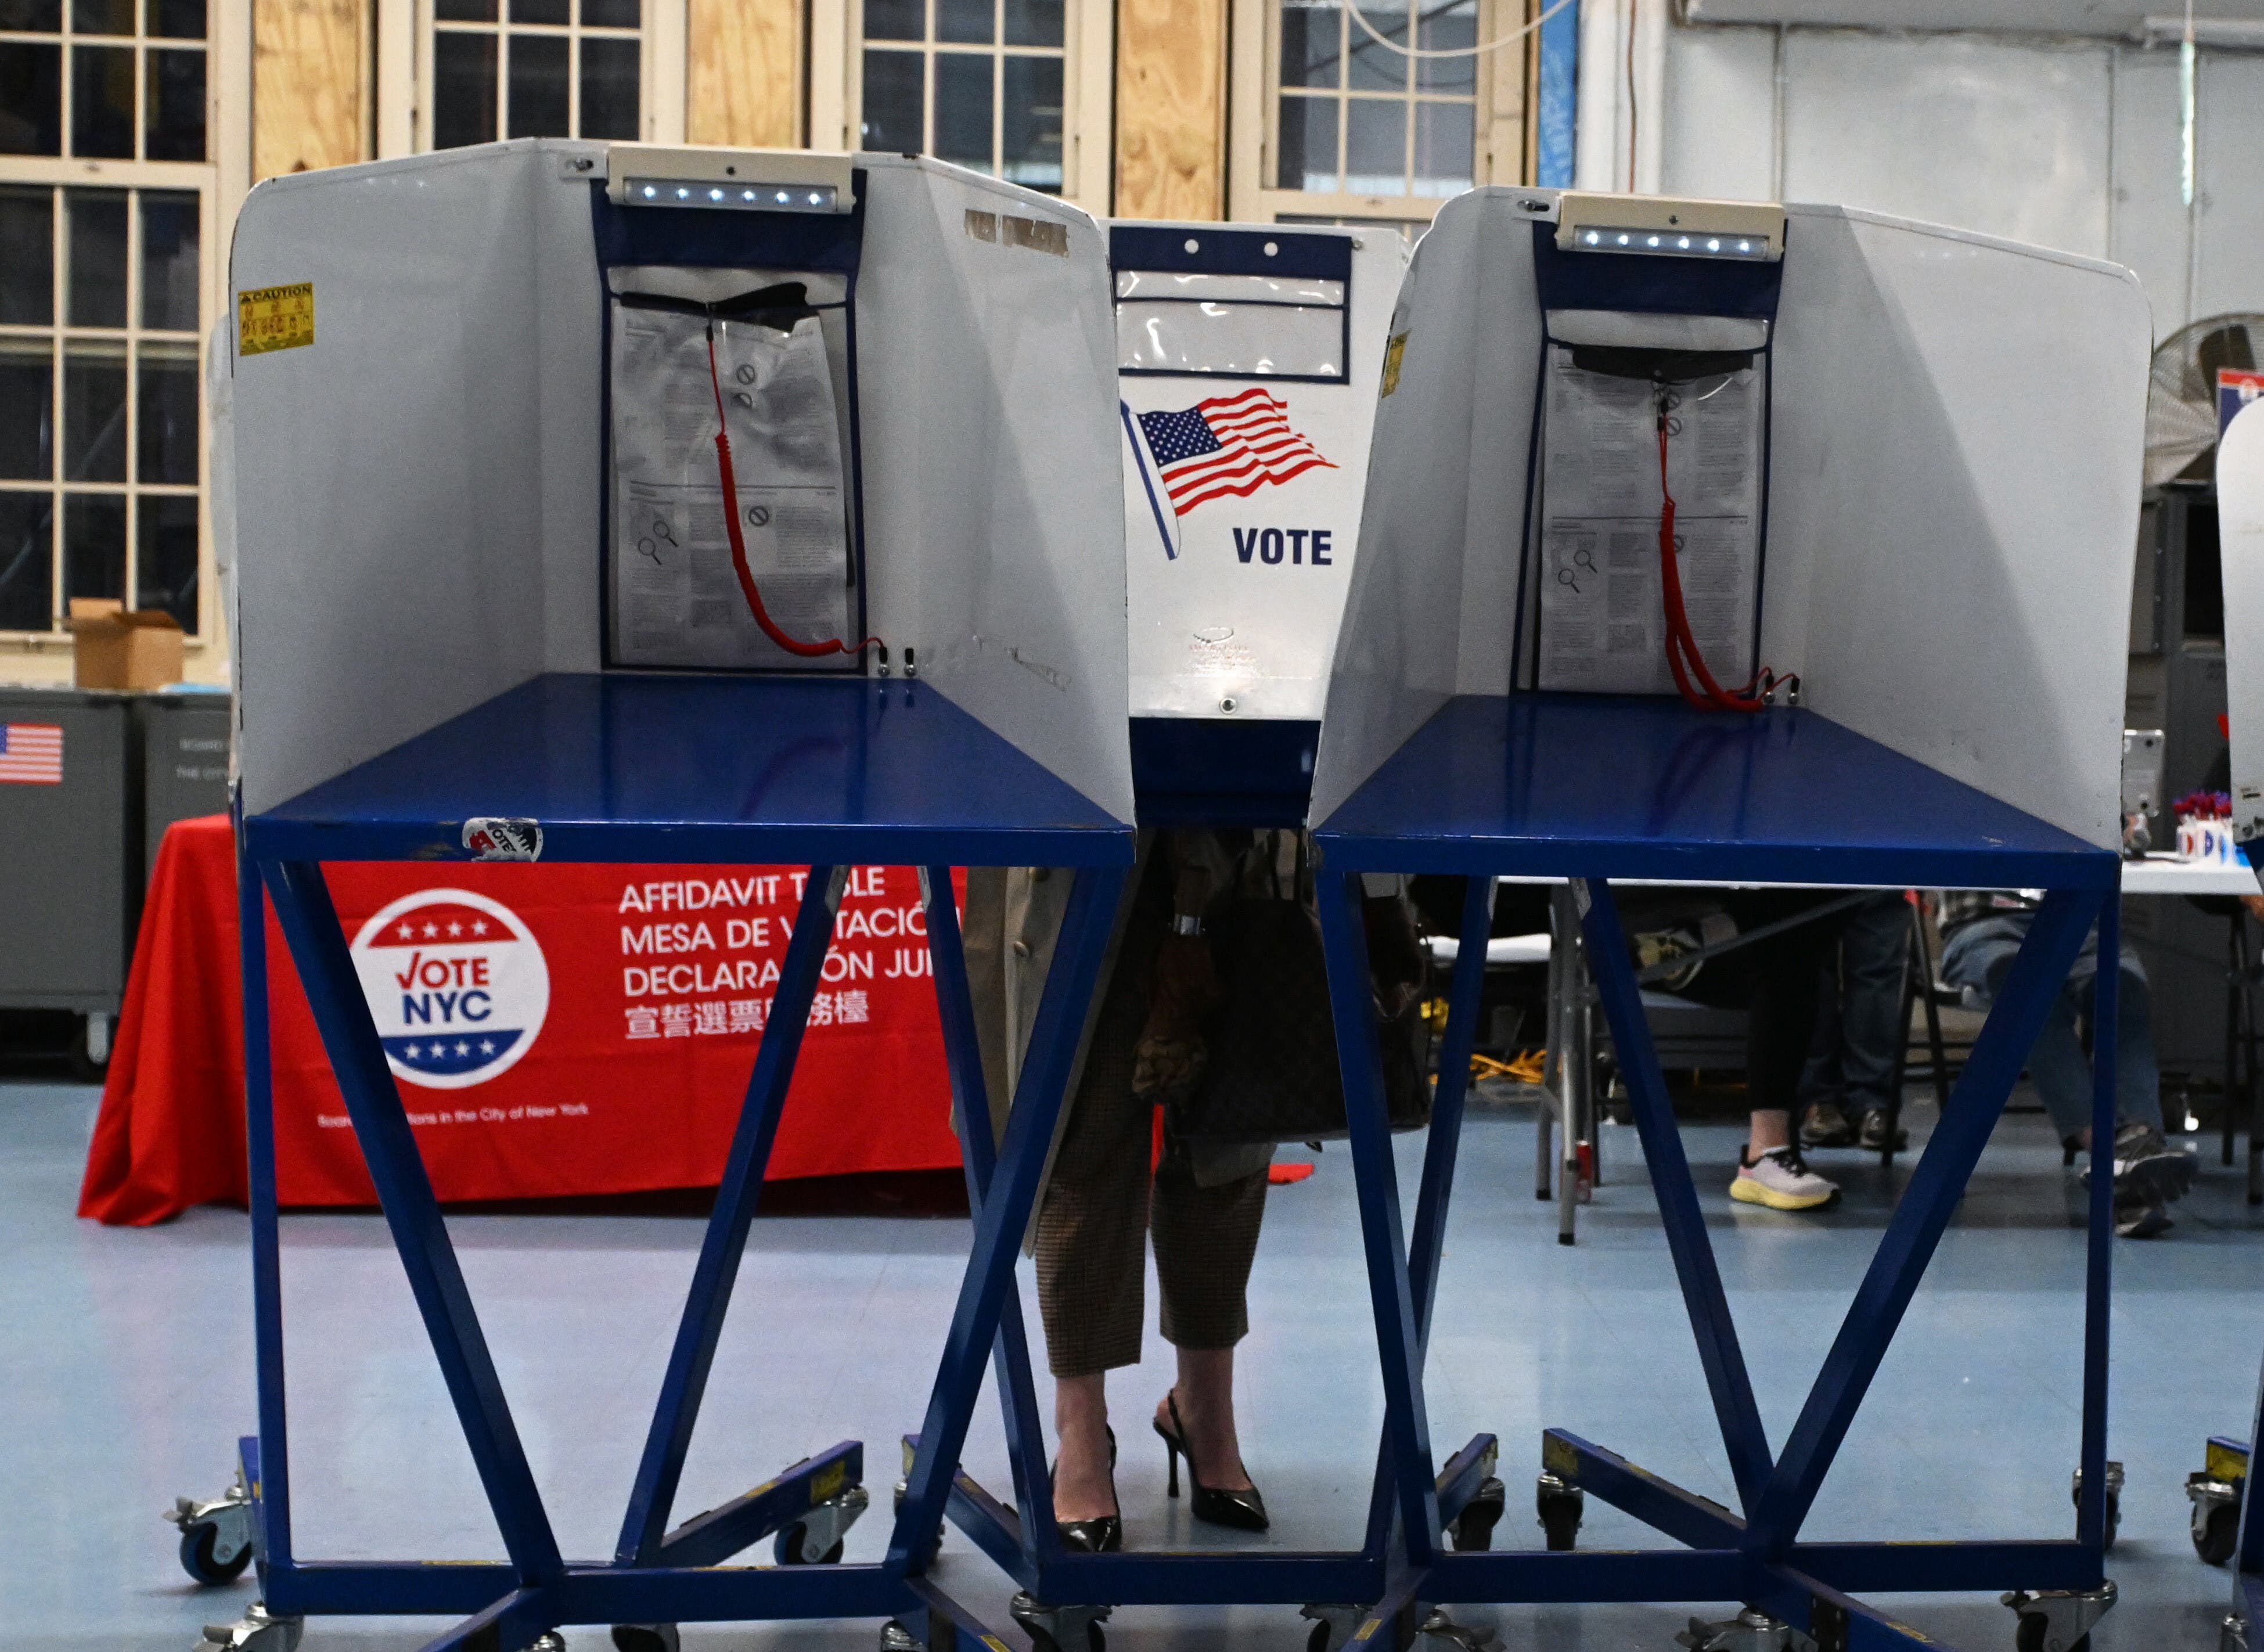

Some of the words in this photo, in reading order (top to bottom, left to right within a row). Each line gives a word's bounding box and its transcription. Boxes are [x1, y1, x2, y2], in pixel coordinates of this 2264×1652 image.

[252, 285, 311, 301] CAUTION
[1232, 527, 1333, 565] VOTE
[618, 875, 781, 914] AFFIDAVIT
[789, 866, 886, 903] TLE
[620, 922, 717, 956] MESA
[726, 917, 771, 949] DE
[395, 949, 490, 990] VOTE
[623, 945, 874, 998] DECLARAÓN
[402, 988, 492, 1026] NYC
[624, 989, 870, 1039] 宣誓選票務檯
[480, 1107, 506, 1122] City
[508, 1106, 524, 1120] of
[525, 1104, 557, 1118] New
